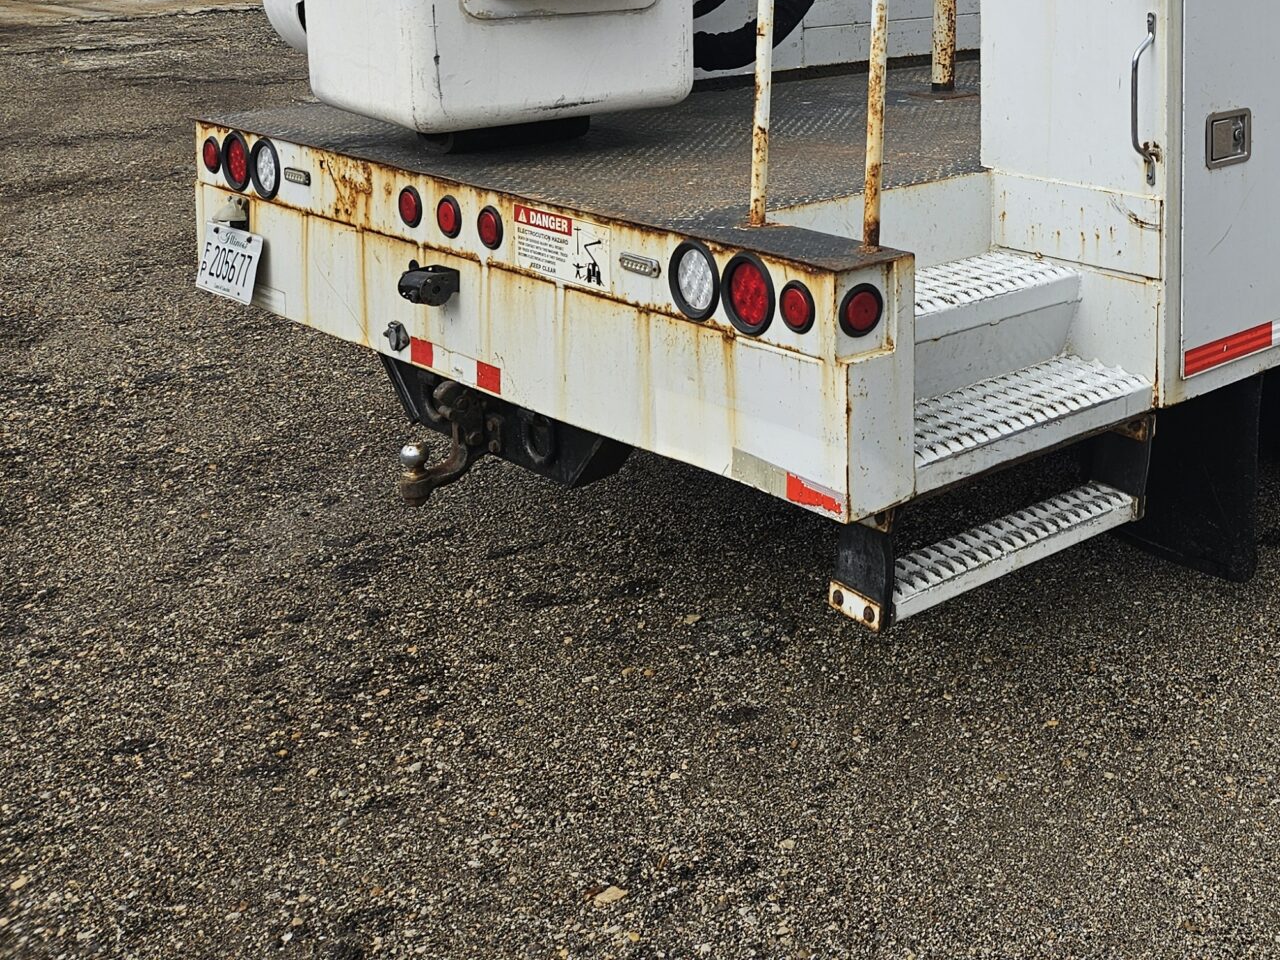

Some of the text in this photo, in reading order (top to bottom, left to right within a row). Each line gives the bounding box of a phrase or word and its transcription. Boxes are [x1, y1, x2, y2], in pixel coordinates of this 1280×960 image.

[529, 211, 568, 232] DANGER
[205, 242, 212, 258] F
[209, 245, 253, 287] 205677
[530, 262, 556, 274] KEEP CLEAR
